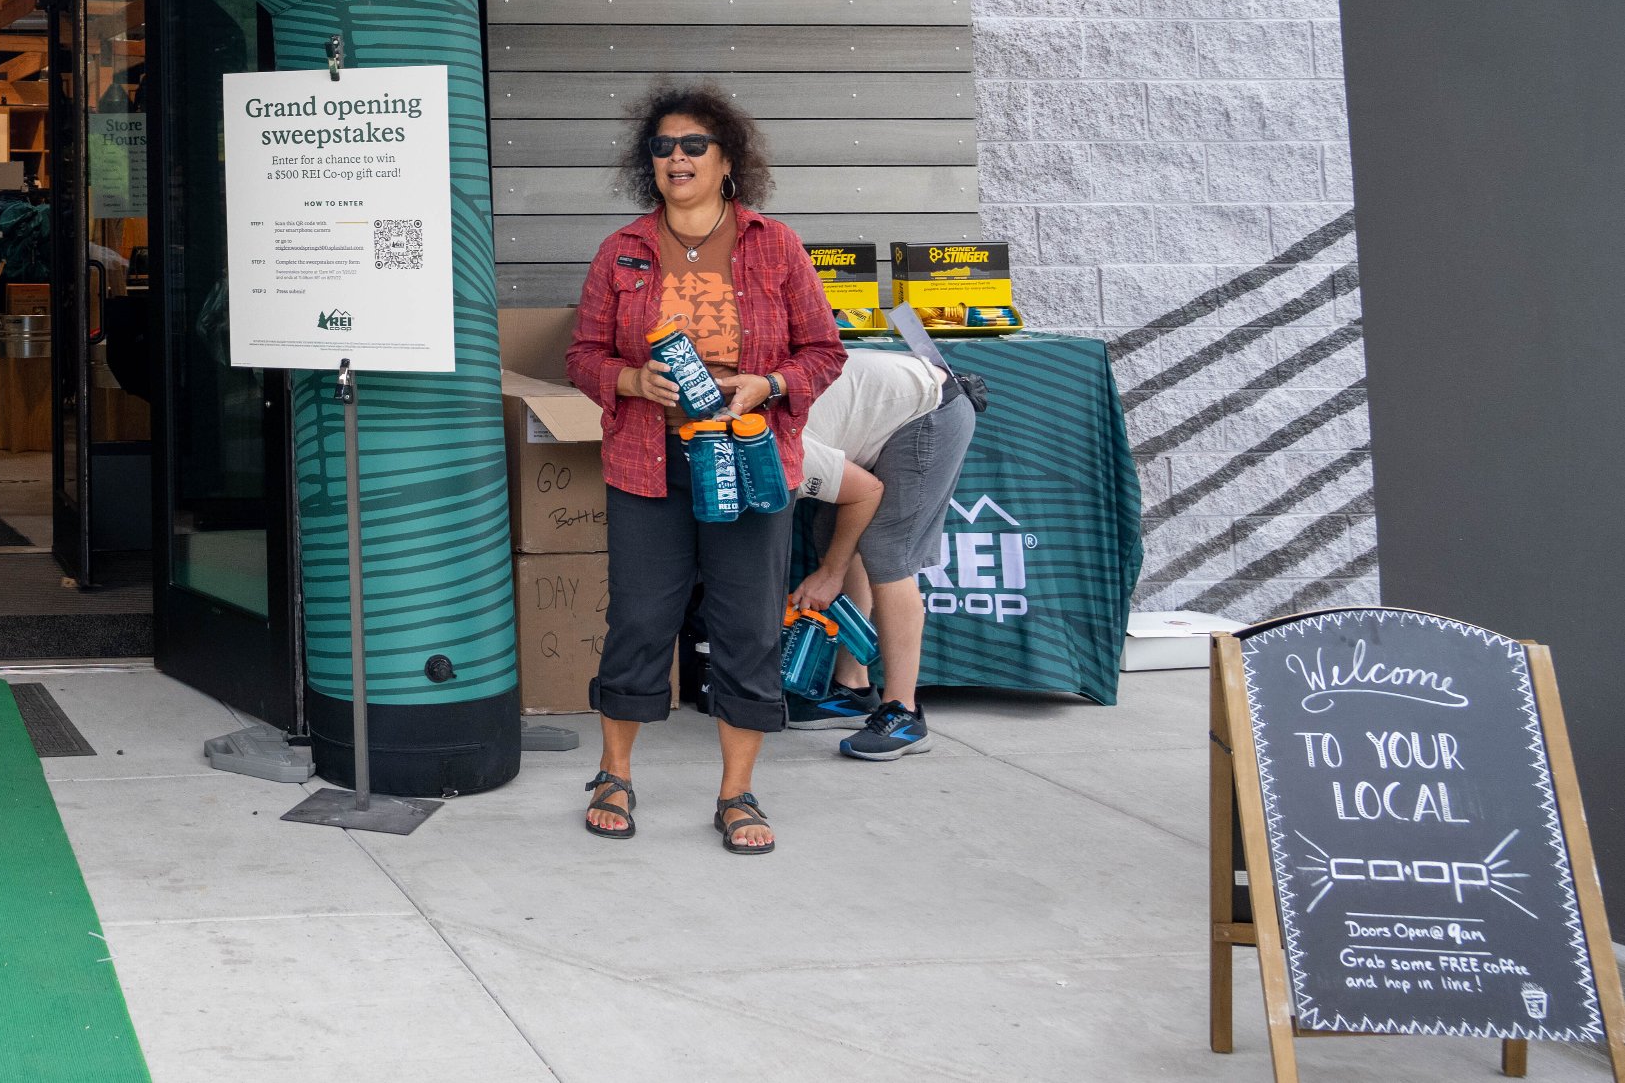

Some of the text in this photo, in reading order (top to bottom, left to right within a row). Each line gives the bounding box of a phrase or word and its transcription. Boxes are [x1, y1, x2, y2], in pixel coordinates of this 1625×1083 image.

[245, 92, 422, 121] Grand opening
[106, 118, 142, 132] Store
[261, 121, 406, 149] sweepstakes
[102, 133, 148, 146] Hours
[271, 153, 396, 166] Enter for a chance to win
[267, 167, 401, 181] a $500 REI Co-op gift card!
[810, 253, 856, 266] STINGER
[942, 251, 989, 263] STINGER
[329, 317, 352, 327] REI
[535, 575, 579, 610] DAY
[1286, 639, 1468, 705] Welcome
[1293, 731, 1465, 770] TO YOUR
[1332, 780, 1470, 823] LOCAL
[1344, 920, 1391, 938] Doors
[1447, 923, 1486, 945] 9am
[1339, 948, 1531, 976] Grab some FREE coffee
[1345, 975, 1378, 989] and
[1384, 975, 1411, 994] hop
[1418, 978, 1433, 990] in
